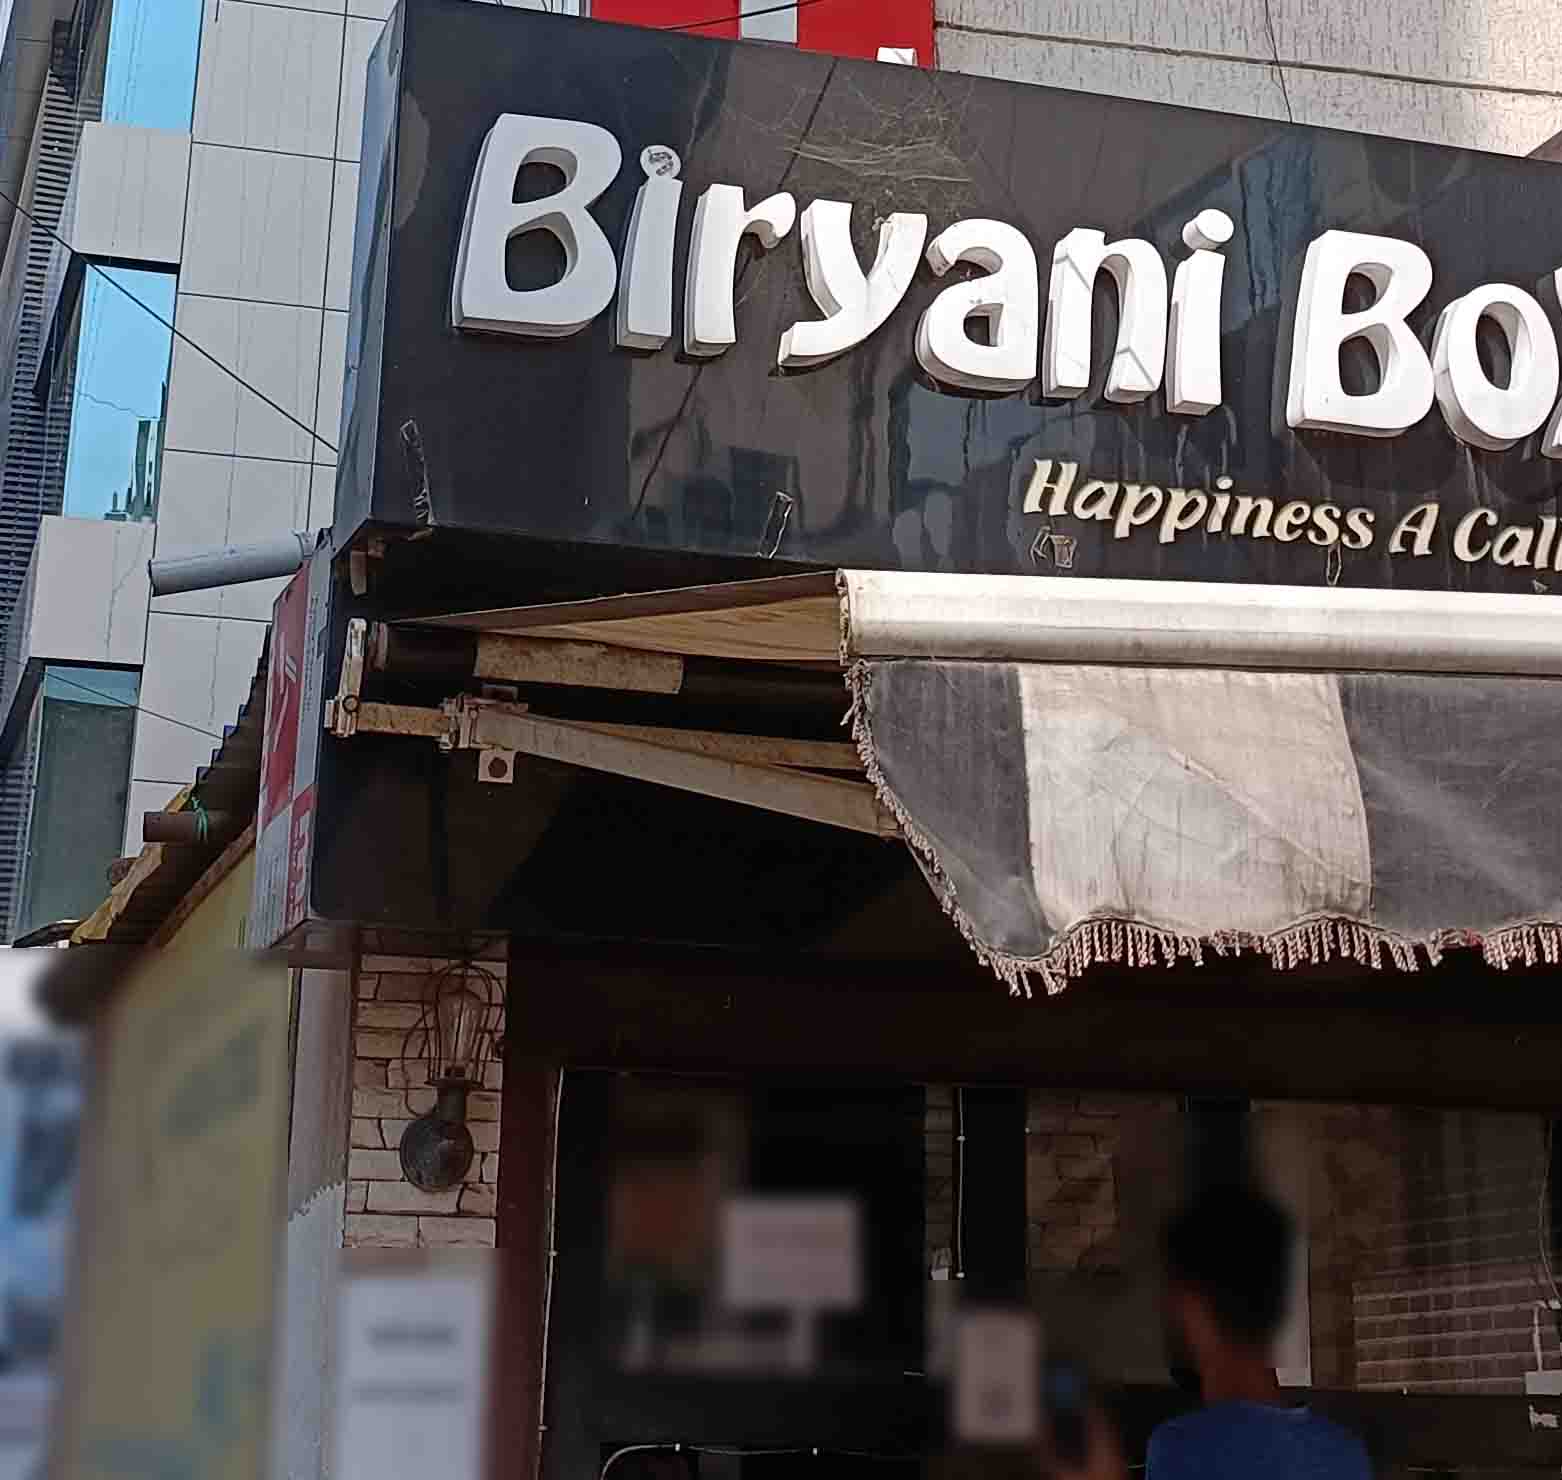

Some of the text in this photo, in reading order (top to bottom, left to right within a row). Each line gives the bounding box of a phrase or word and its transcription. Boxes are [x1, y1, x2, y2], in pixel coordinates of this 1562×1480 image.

[451, 112, 1235, 414] Biryani
[1022, 457, 1376, 549] Happiness
[1388, 502, 1440, 556] A
